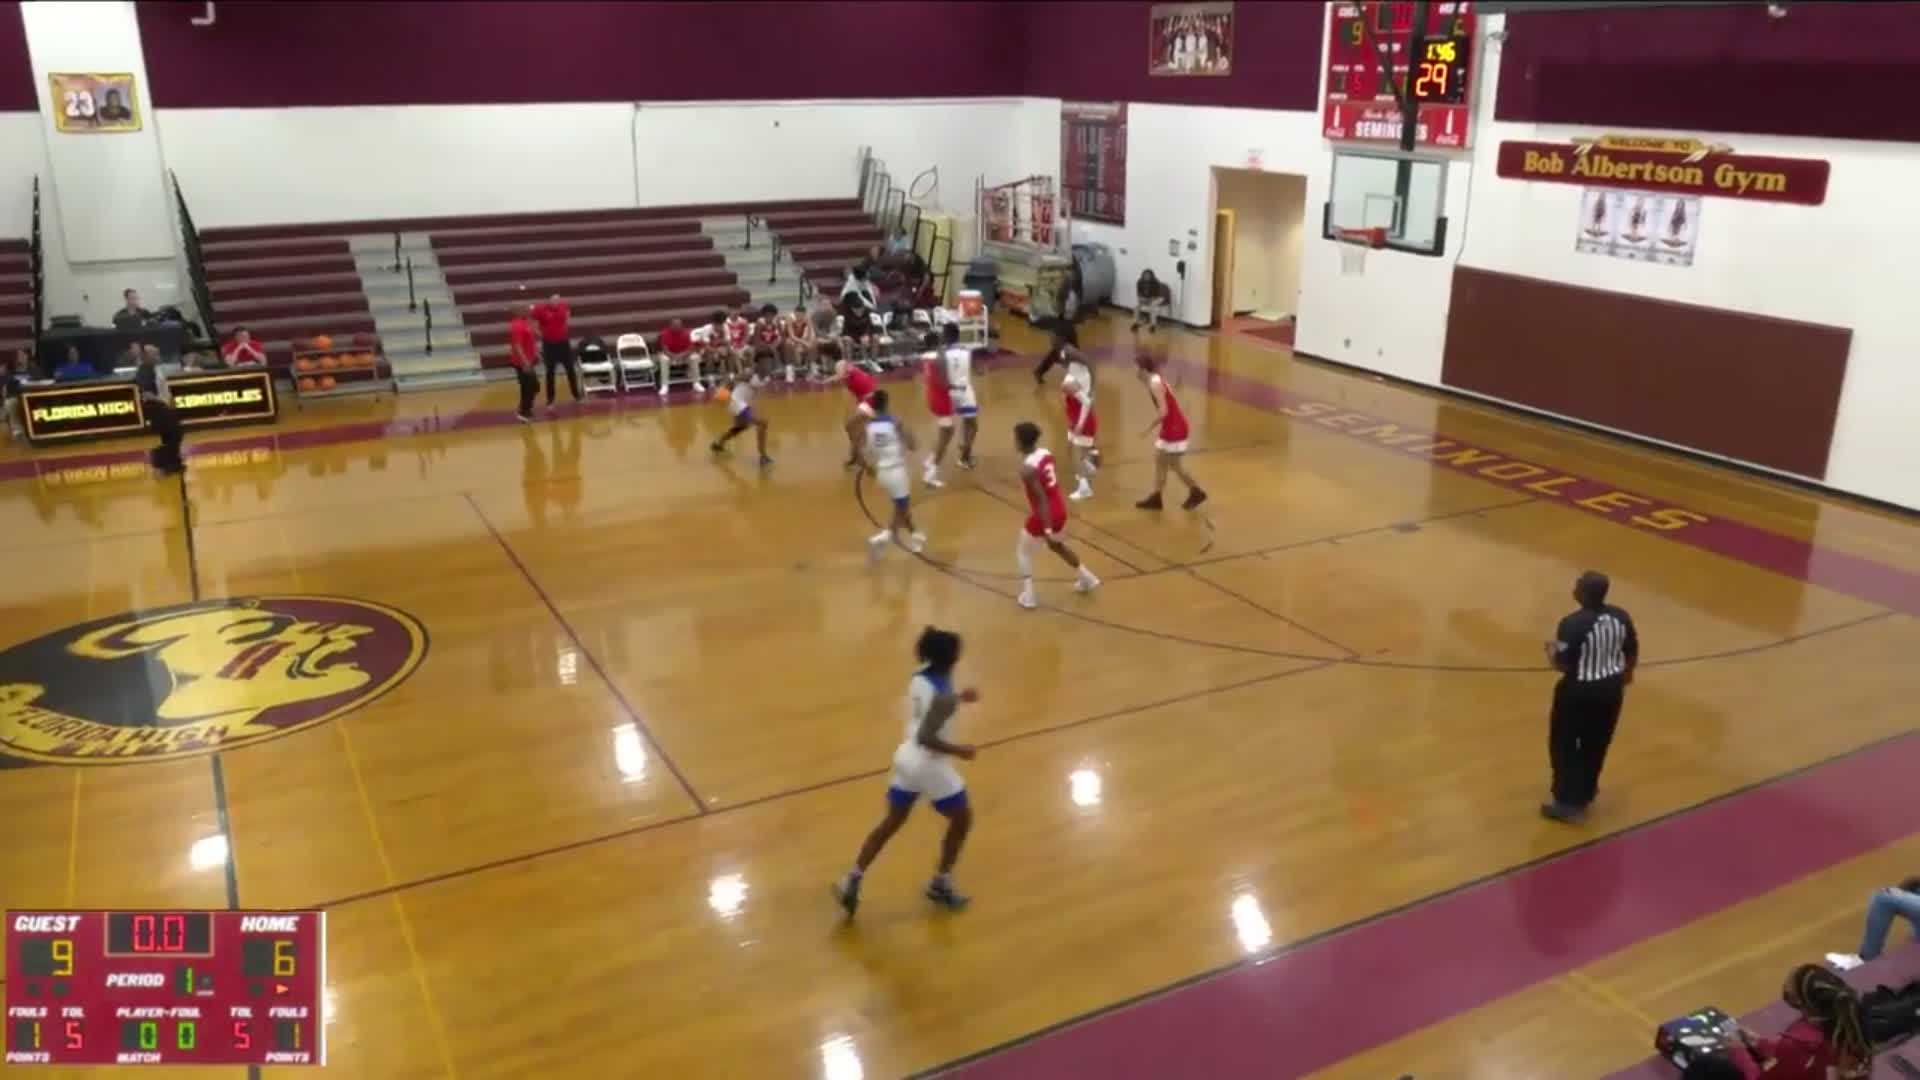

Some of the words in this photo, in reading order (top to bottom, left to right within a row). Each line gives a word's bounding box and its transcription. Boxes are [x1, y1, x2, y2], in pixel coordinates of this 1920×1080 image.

[1416, 63, 1447, 96] 29
[1355, 120, 1428, 141] SEMINS
[1524, 151, 1564, 174] Bob
[1571, 153, 1704, 186] Albertson
[1713, 163, 1787, 194] Gym
[33, 406, 97, 421] FLORIDA
[99, 401, 135, 416] HIGH
[174, 388, 262, 408] SEMINOLES
[1282, 401, 1709, 531] SEMINOLES
[8, 706, 121, 742] FLORIDA
[125, 725, 229, 743] HIGH
